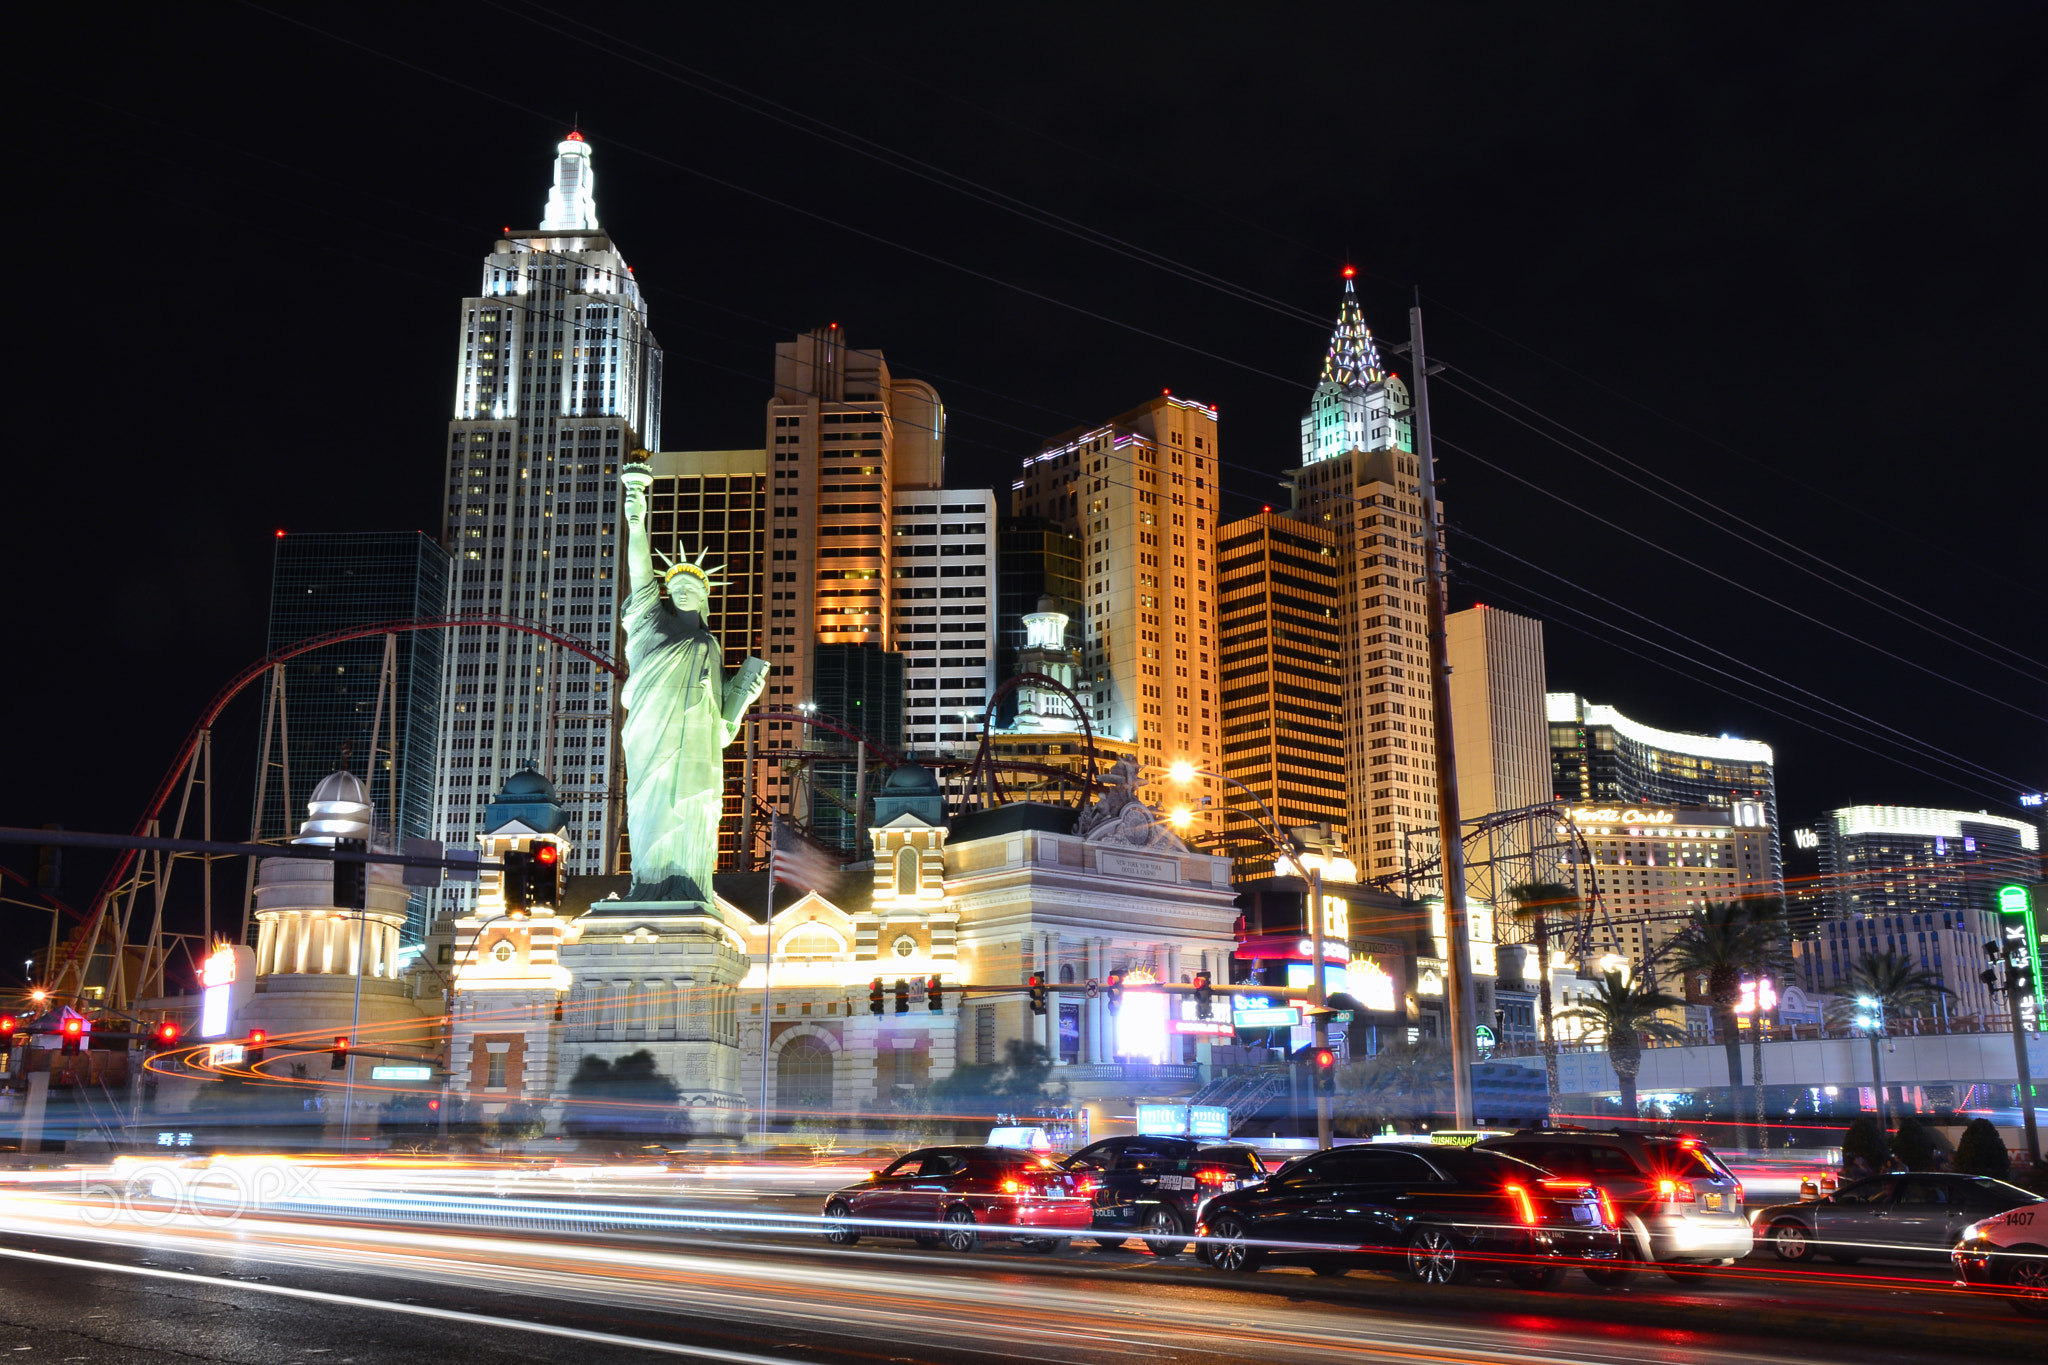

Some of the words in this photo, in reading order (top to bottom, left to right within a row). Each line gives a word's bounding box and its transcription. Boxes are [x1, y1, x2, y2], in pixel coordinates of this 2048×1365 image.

[2020, 794, 2043, 806] THE
[1621, 809, 1674, 824] Carlo
[1095, 1209, 1117, 1217] SOLEIL
[2006, 1212, 2035, 1226] 1407
